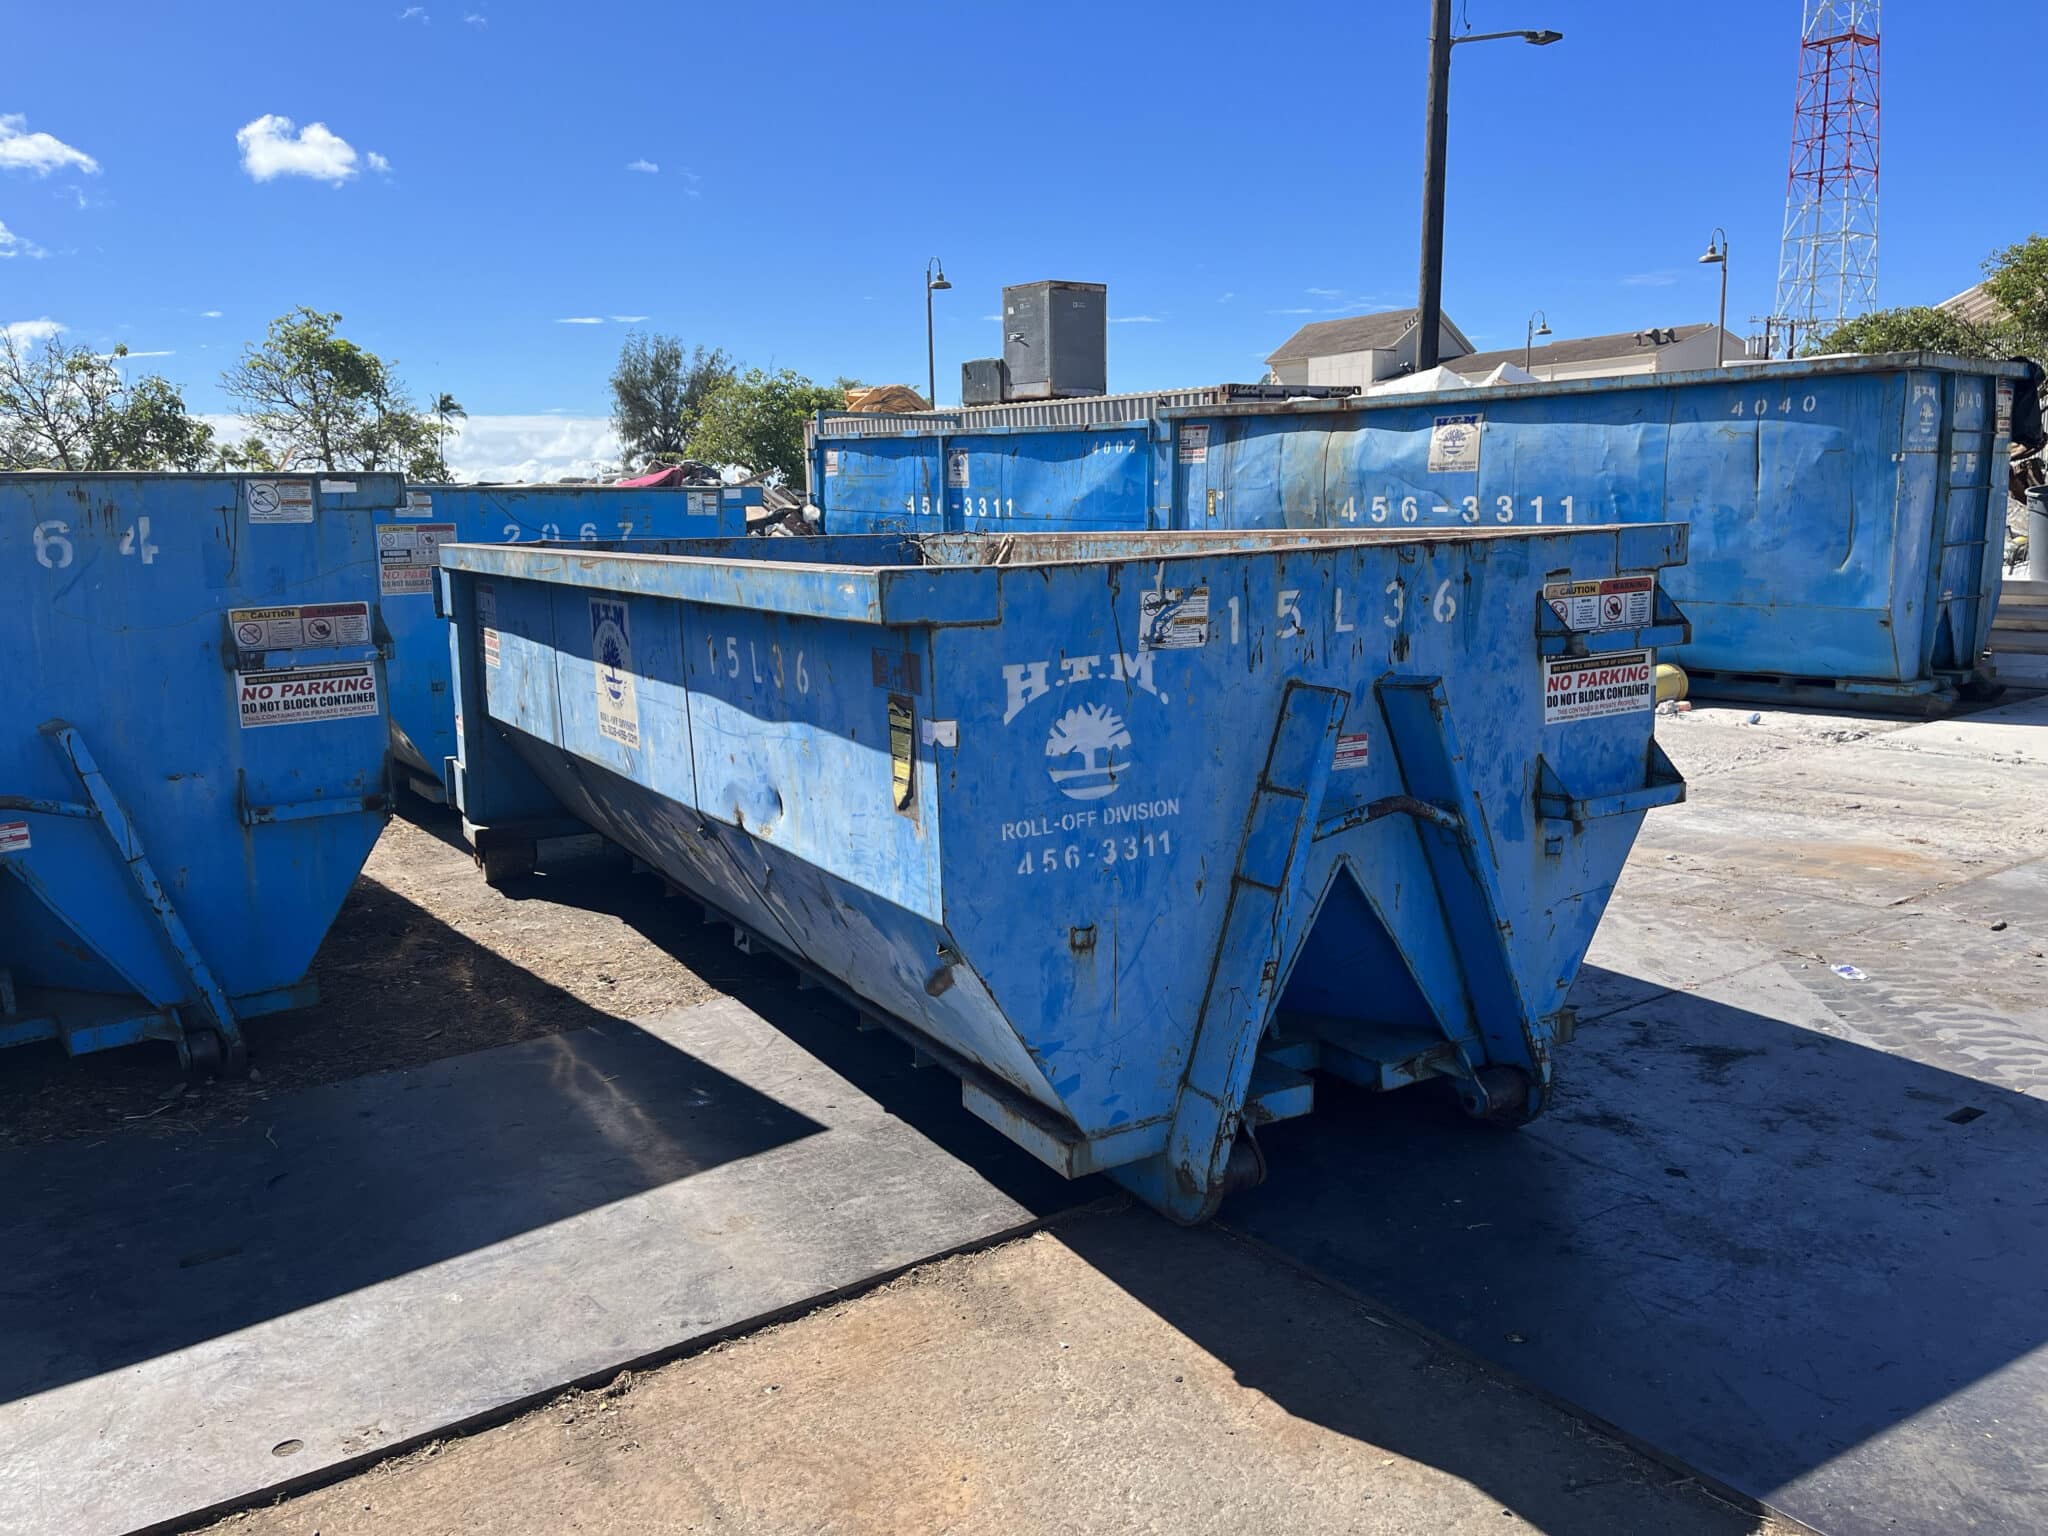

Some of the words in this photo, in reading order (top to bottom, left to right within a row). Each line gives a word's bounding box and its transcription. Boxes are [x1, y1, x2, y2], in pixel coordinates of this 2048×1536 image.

[1731, 395, 1817, 417] 4040
[1341, 496, 1573, 524] 456-3311
[503, 522, 633, 543] 2067
[1560, 586, 1596, 595] CAUTION
[250, 610, 295, 620] CAUTION
[242, 686, 273, 701] NO
[280, 677, 374, 698] PARKING
[1547, 674, 1572, 692] NO
[1577, 665, 1649, 689] PARKING
[242, 703, 257, 714] DO
[260, 700, 281, 713] NOT
[283, 697, 318, 710] BLOCK
[319, 692, 376, 707] CONTAINER
[1547, 694, 1558, 708] DO
[1560, 692, 1577, 705] NOT
[1579, 688, 1605, 703] BLOCK
[1606, 683, 1649, 699] CONTAINER
[1001, 810, 1097, 841] ROLL-OFF
[1103, 797, 1180, 826] DIVISION
[1017, 830, 1171, 875] 456-3311
